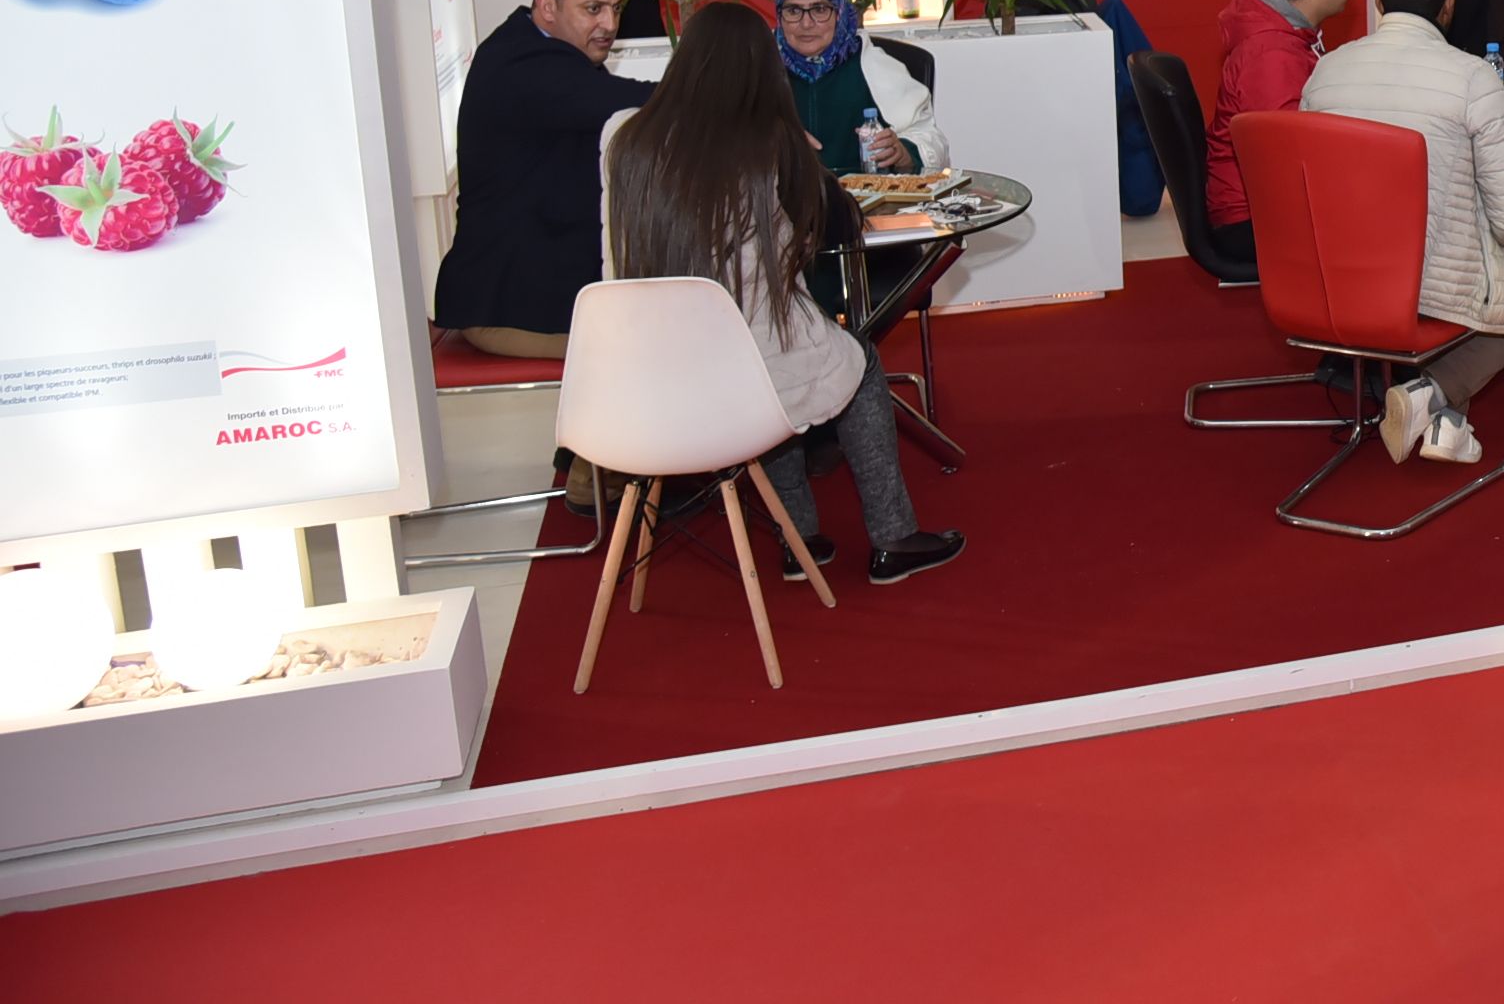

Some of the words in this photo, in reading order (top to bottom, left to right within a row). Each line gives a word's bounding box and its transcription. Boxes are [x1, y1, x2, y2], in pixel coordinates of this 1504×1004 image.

[3, 372, 22, 381] pour
[24, 369, 36, 377] les
[111, 359, 135, 369] thrips
[136, 358, 144, 366] et
[313, 368, 344, 378] FMC
[4, 384, 22, 393] d'un
[24, 381, 44, 391] large
[46, 378, 75, 389] spectre
[76, 377, 86, 385] de
[28, 395, 37, 403] et
[38, 390, 83, 402] compatible
[227, 409, 267, 421] Importé
[269, 407, 279, 416] et
[215, 420, 323, 446] AMAROC
